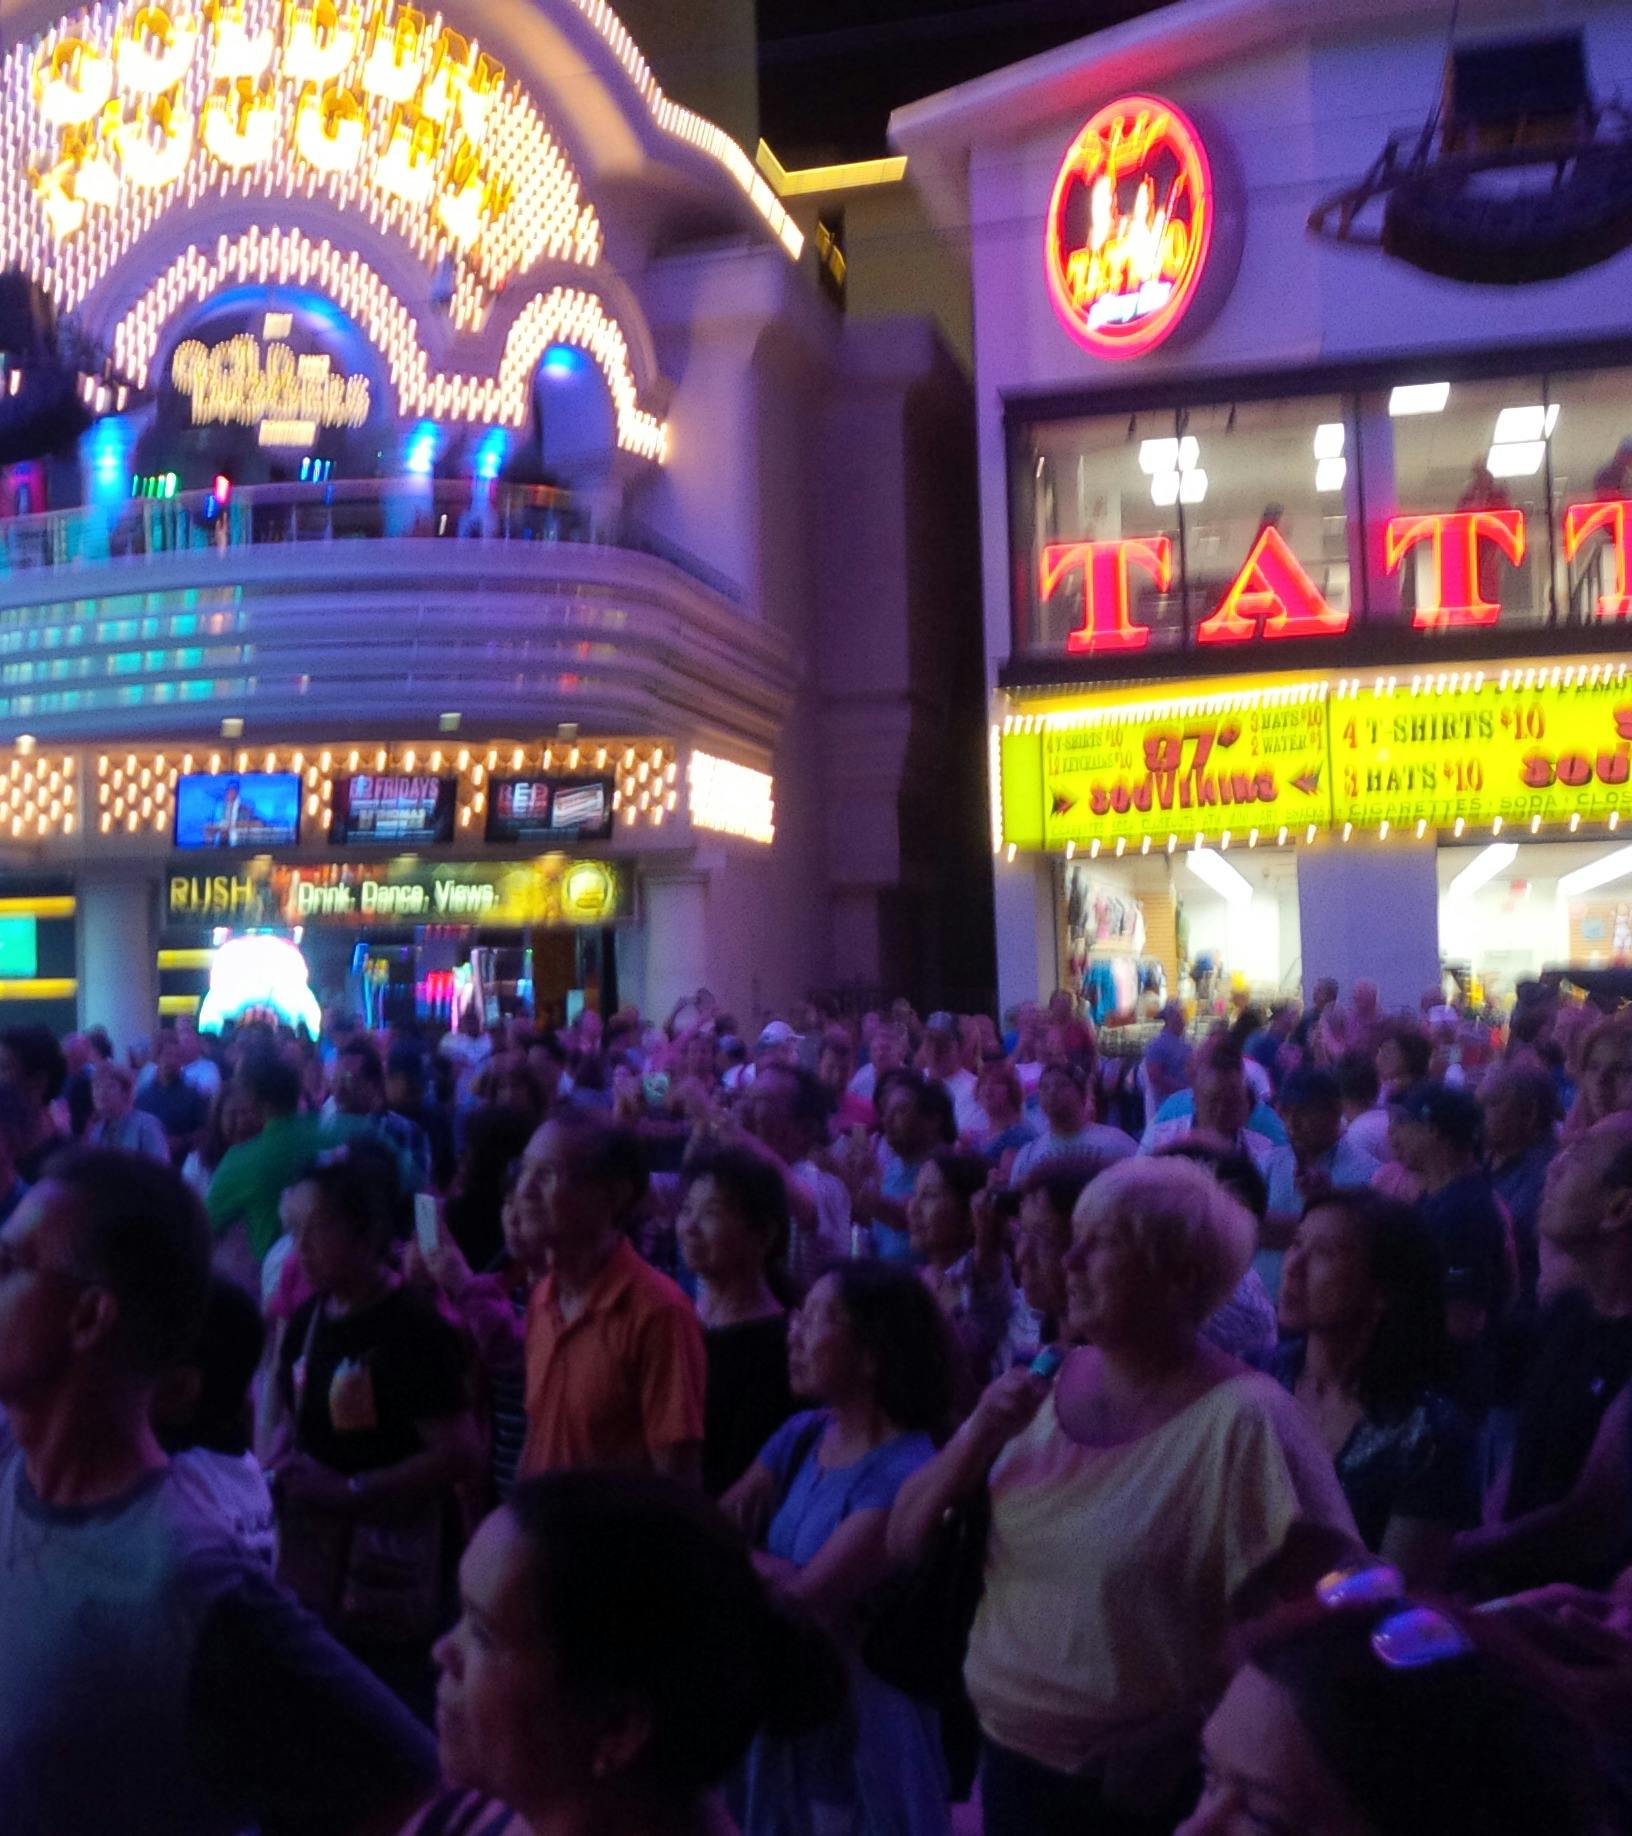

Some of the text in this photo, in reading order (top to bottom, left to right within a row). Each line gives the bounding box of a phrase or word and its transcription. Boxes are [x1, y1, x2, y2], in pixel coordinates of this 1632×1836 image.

[1261, 710, 1299, 729] HATS
[1367, 709, 1494, 743] T-SHIRTS
[1500, 703, 1545, 740] $10
[1367, 761, 1436, 792] HATS
[1349, 797, 1482, 818] CIGARETTES
[1500, 792, 1558, 810] SODA
[169, 876, 253, 910] RUSH
